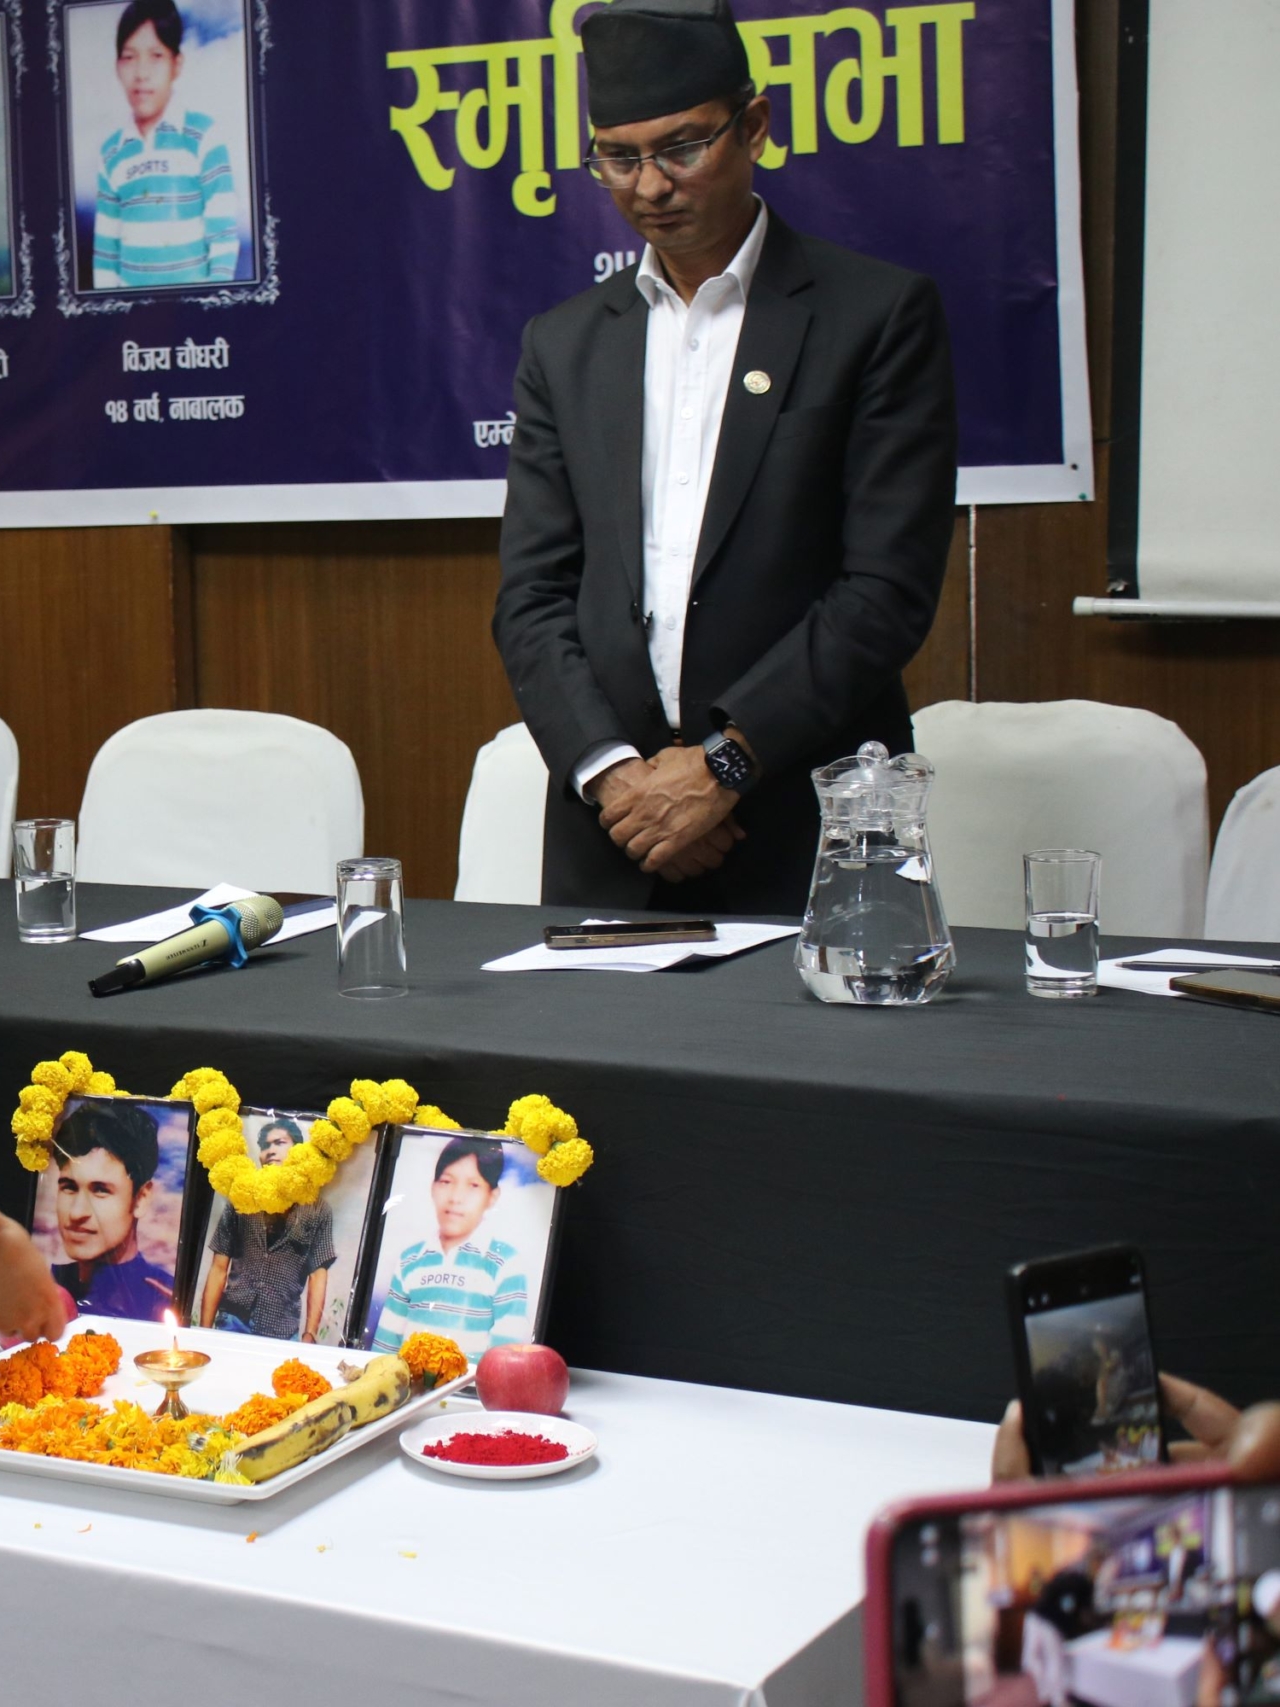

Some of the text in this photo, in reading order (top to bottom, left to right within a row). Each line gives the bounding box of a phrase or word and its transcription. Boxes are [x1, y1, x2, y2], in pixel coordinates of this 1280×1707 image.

[122, 340, 171, 372] विजय
[168, 395, 245, 420] नाबालक
[420, 1273, 466, 1287] SPORTS
